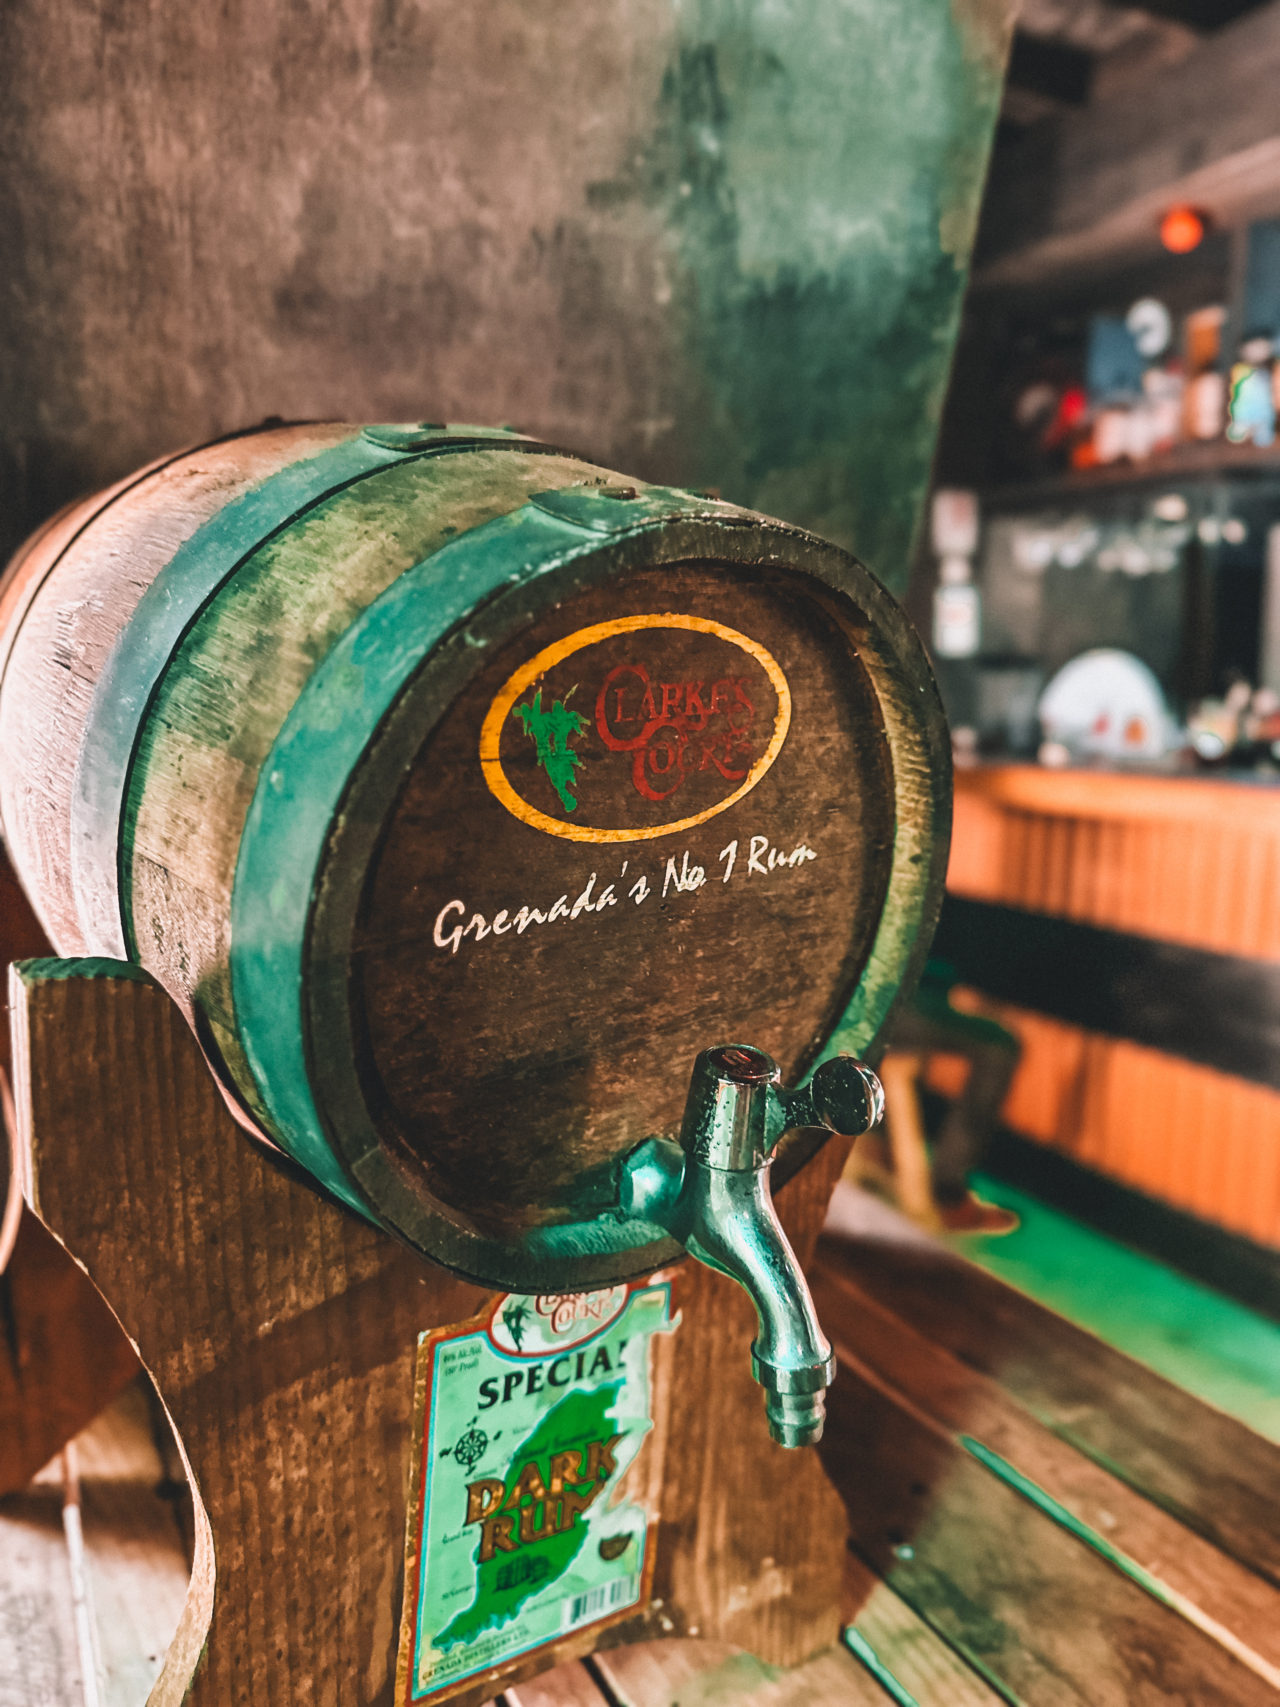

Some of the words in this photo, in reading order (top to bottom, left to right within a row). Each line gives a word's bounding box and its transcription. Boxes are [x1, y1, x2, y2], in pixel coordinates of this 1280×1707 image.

[433, 860, 650, 954] Grenada's
[719, 840, 738, 883] 1
[748, 835, 817, 876] Rum
[463, 1430, 631, 1527] DARK
